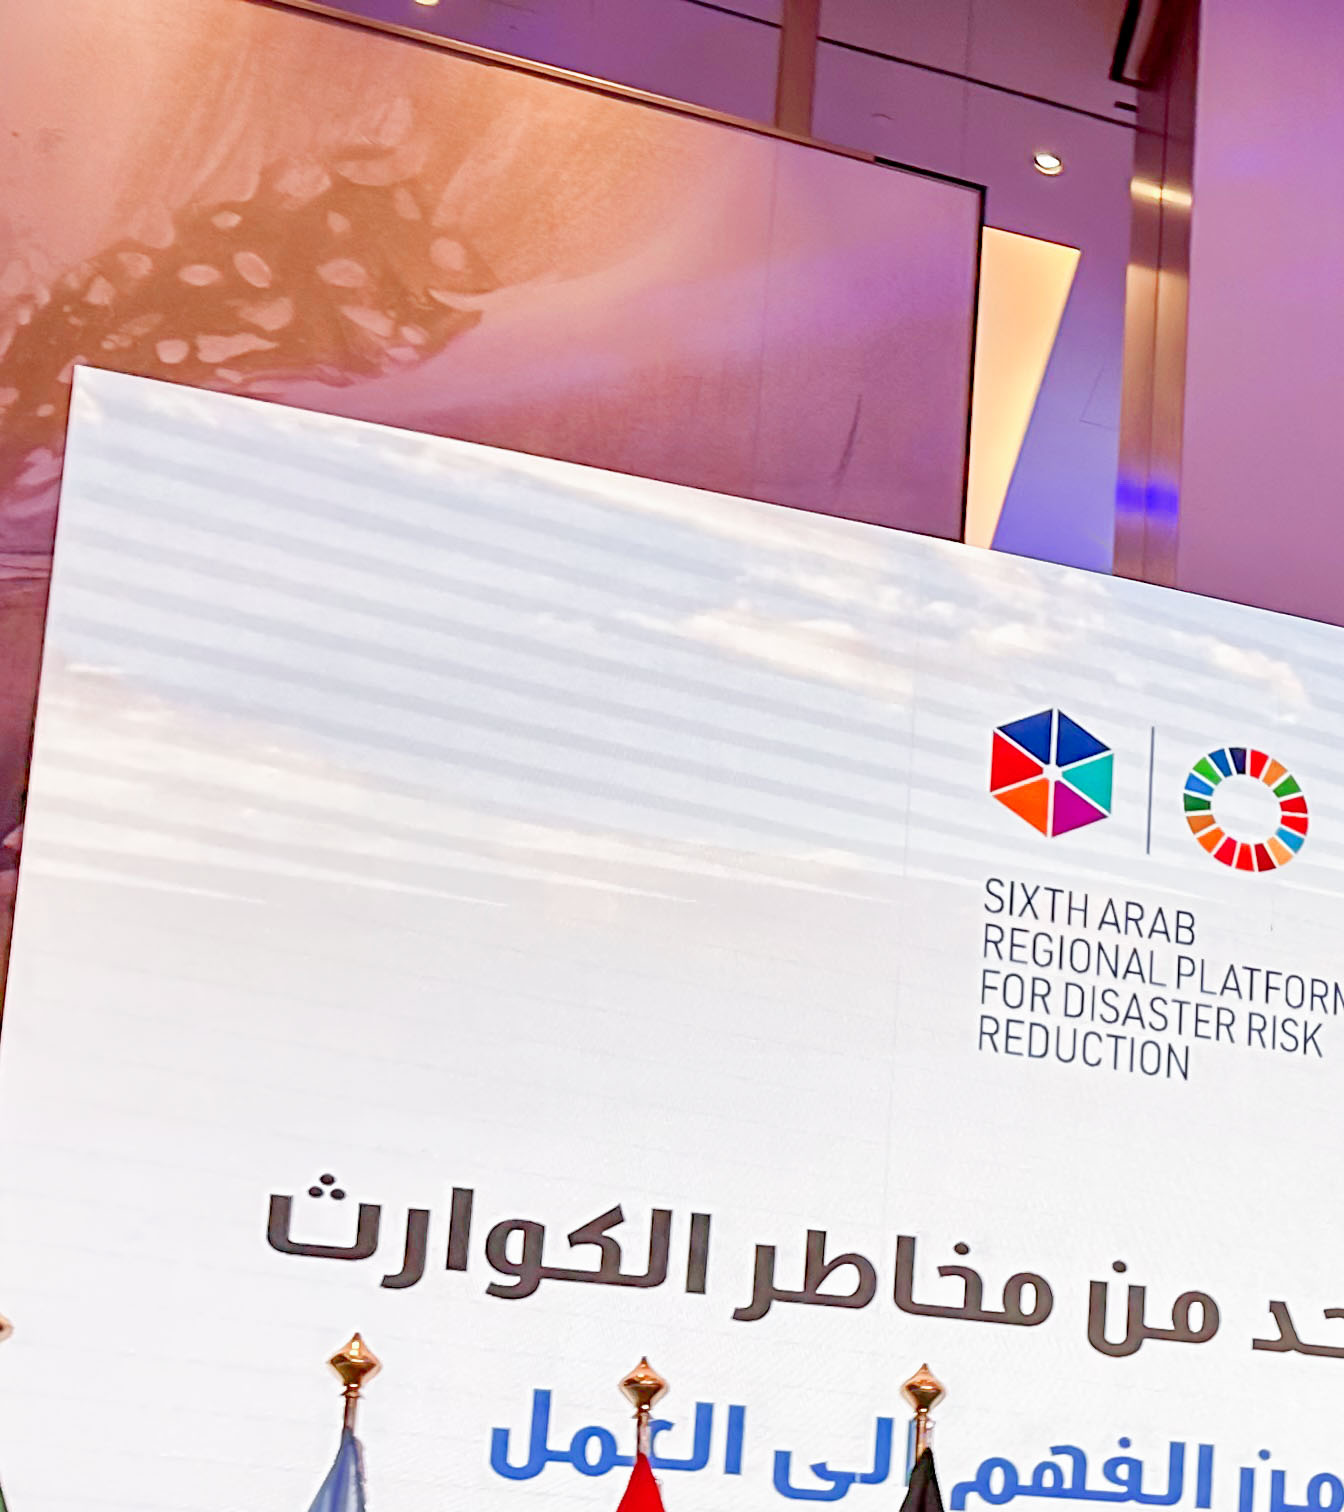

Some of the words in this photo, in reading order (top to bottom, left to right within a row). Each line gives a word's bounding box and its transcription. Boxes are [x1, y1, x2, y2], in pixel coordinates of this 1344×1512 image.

[984, 878, 1088, 928] SIXTH
[1098, 898, 1195, 946] ARAB
[984, 923, 1167, 987] REGIONAL
[979, 1014, 1189, 1080] REDUCTION
[981, 969, 1051, 1015] FOR
[1064, 982, 1235, 1044] DISASTER
[1248, 1012, 1323, 1058] RISK
[266, 1173, 712, 1301] الكوارث
[730, 1229, 1054, 1327] مخاطر
[1087, 1260, 1221, 1358] من
[489, 1388, 746, 1480] العمل
[949, 1437, 1215, 1512] الفهم
